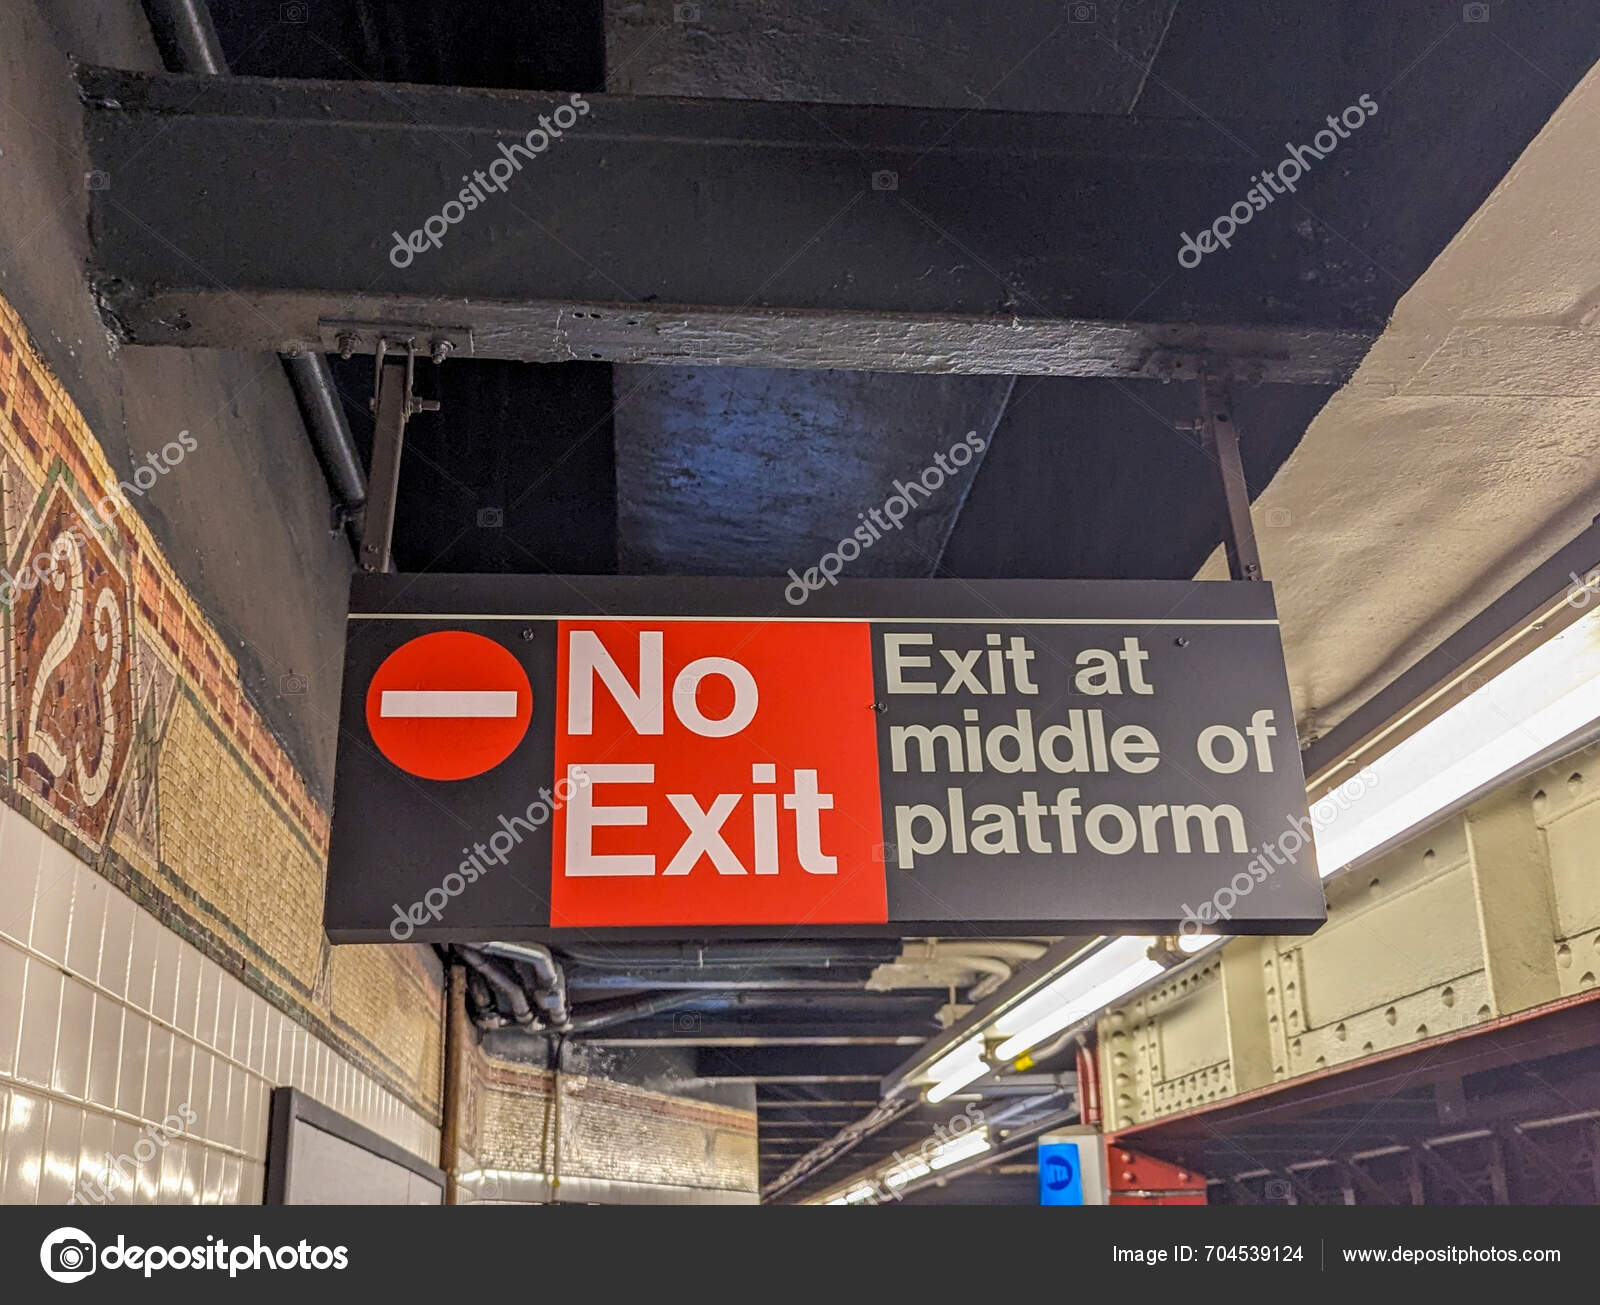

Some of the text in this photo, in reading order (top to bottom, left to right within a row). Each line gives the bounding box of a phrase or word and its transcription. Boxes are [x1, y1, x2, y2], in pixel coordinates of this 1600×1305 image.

[568, 631, 759, 737] No
[884, 633, 1154, 696] Exit at
[889, 709, 1279, 774] middle of
[566, 763, 838, 877] Exit
[894, 787, 1248, 870] platform
